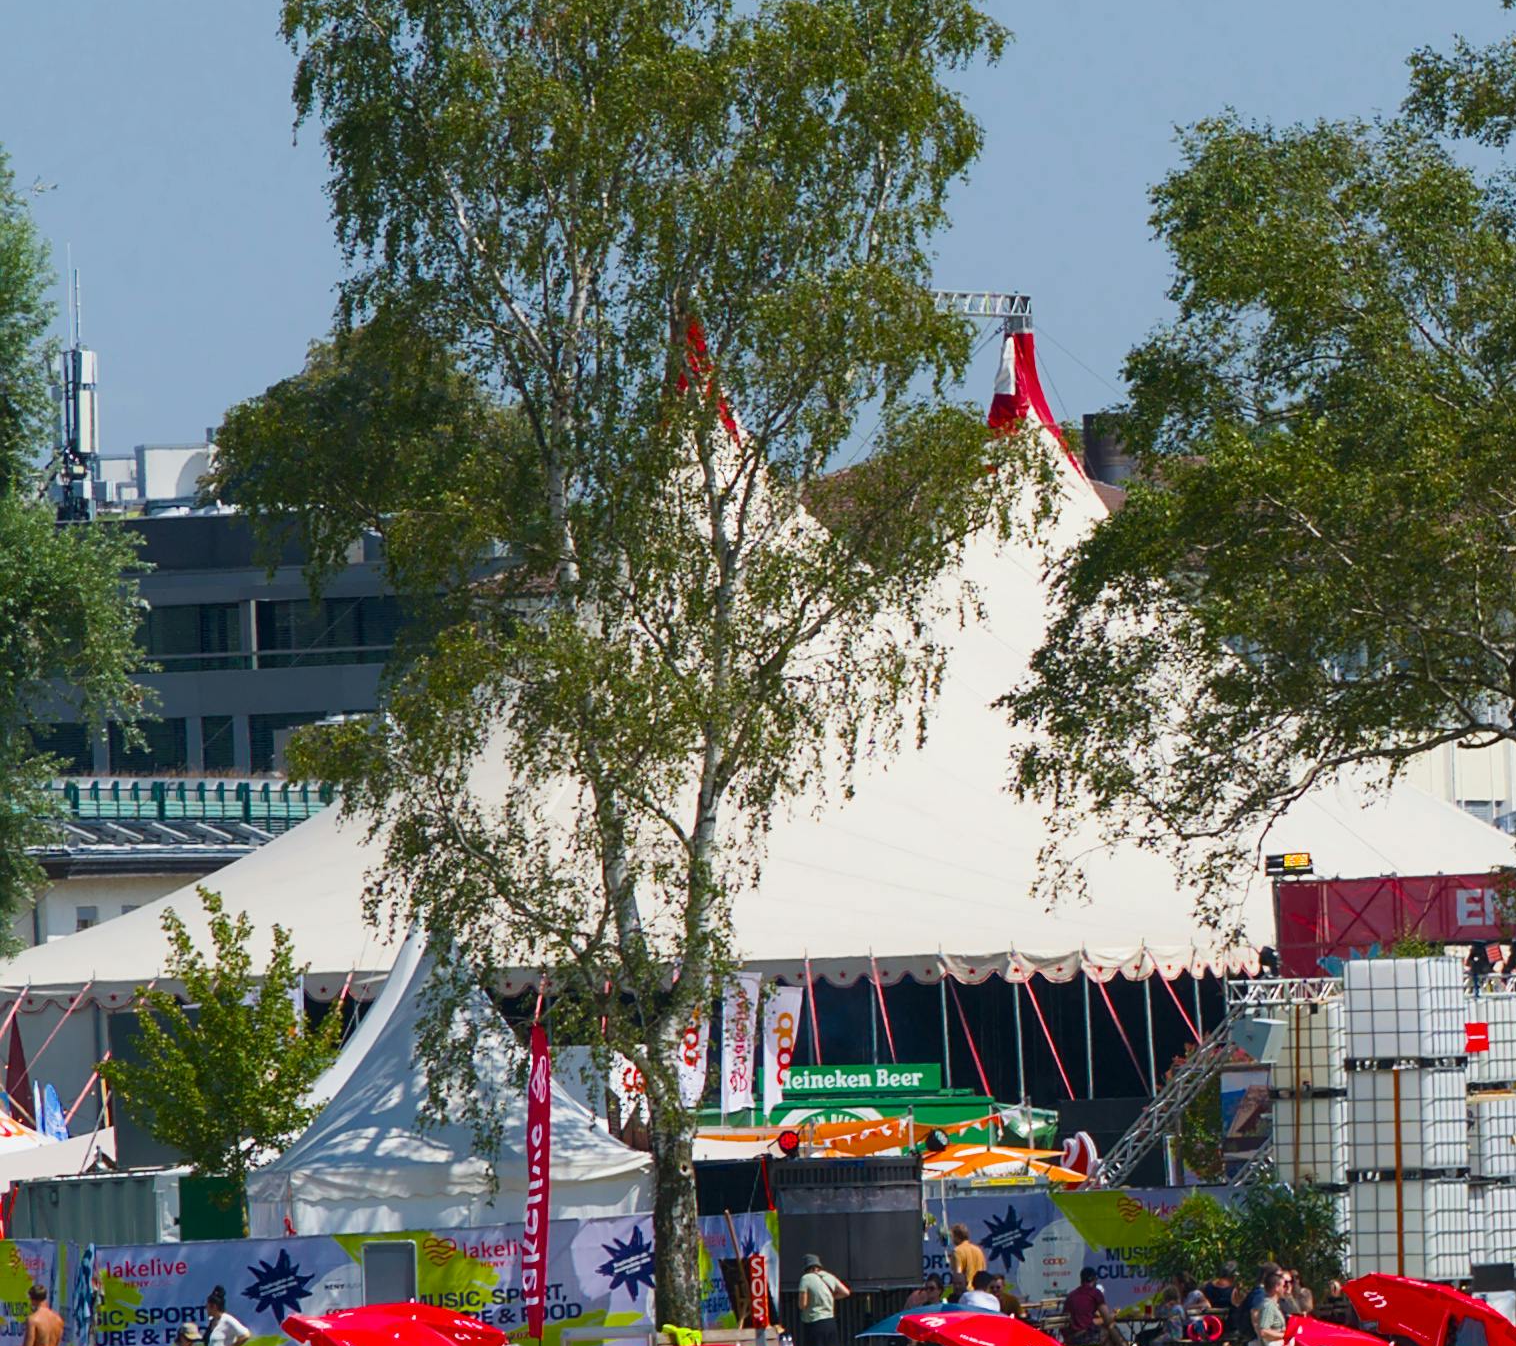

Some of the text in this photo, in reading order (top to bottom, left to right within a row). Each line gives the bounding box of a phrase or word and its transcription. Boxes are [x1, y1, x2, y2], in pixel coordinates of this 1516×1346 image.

[875, 1068, 924, 1088] Beer
[106, 1258, 187, 1278] lakelive
[750, 1256, 765, 1319] SOS
[497, 1309, 515, 1324] &
[141, 1328, 160, 1345] &
